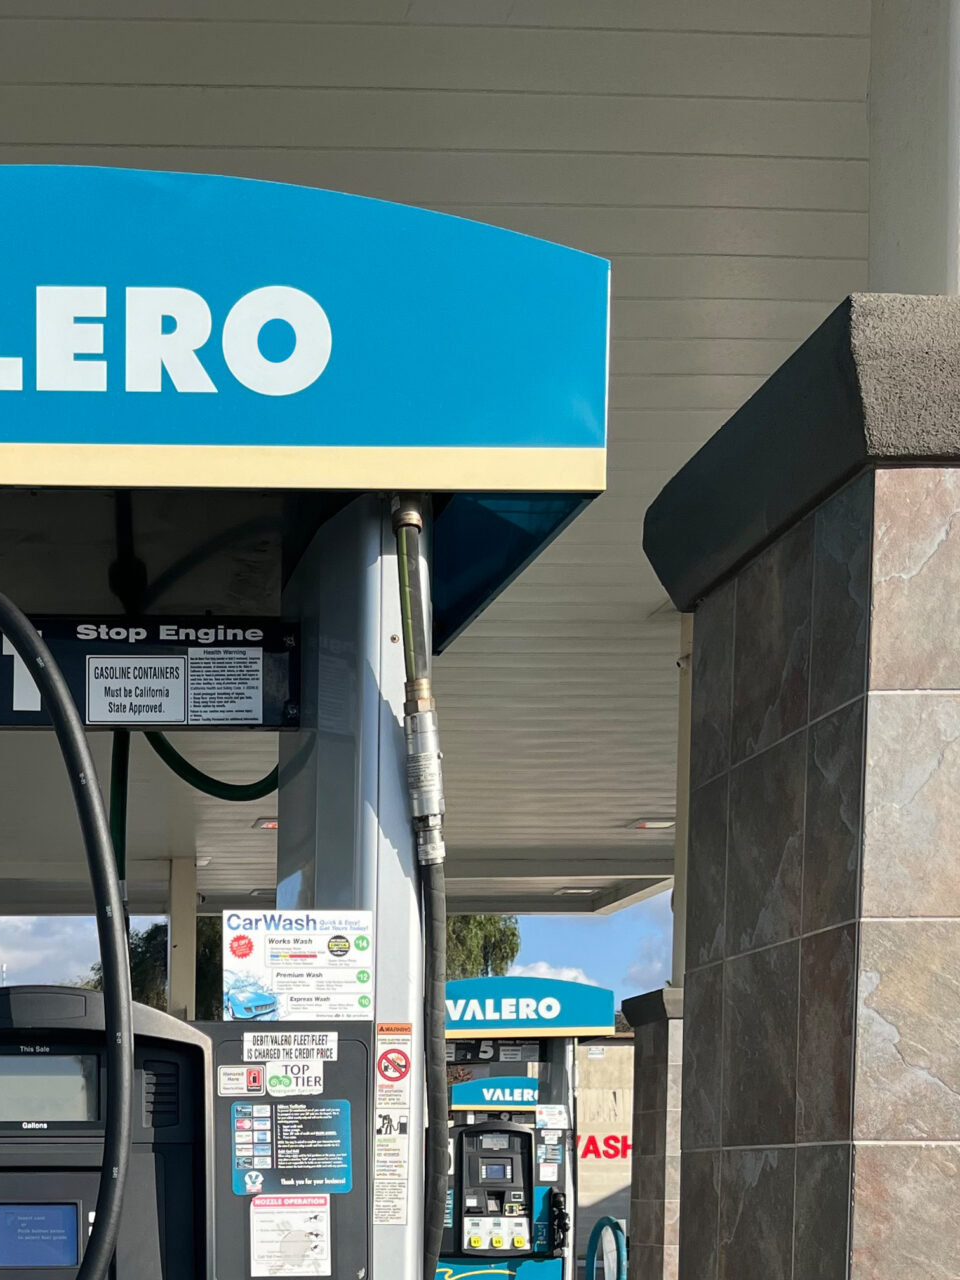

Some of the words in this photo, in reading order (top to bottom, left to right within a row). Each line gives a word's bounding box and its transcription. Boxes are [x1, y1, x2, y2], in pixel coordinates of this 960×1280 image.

[76, 624, 147, 643] Stop
[159, 625, 264, 644] Engine
[94, 666, 131, 680] GASOLINE
[132, 666, 180, 680] CONTAINERS
[104, 686, 123, 698] Must
[124, 686, 133, 698] be
[134, 686, 170, 698] California
[108, 702, 127, 713] State
[129, 702, 165, 715] Approved.
[226, 913, 317, 931] CarWash
[444, 997, 561, 1021] VALERO
[252, 1035, 292, 1046] DEBIT/VALERO
[294, 1034, 328, 1046] FLEET/FLEET
[247, 1049, 253, 1059] IS
[254, 1048, 280, 1059] CHARGED
[282, 1048, 293, 1059] THE
[294, 1048, 315, 1059] CREDIT
[316, 1048, 333, 1059] PRICE
[478, 1040, 494, 1060] 5
[282, 1064, 310, 1076] TOP
[294, 1076, 322, 1087] TIER
[22, 1121, 48, 1129] Gallons
[576, 1135, 632, 1159] ASH
[324, 1177, 346, 1185] business!
